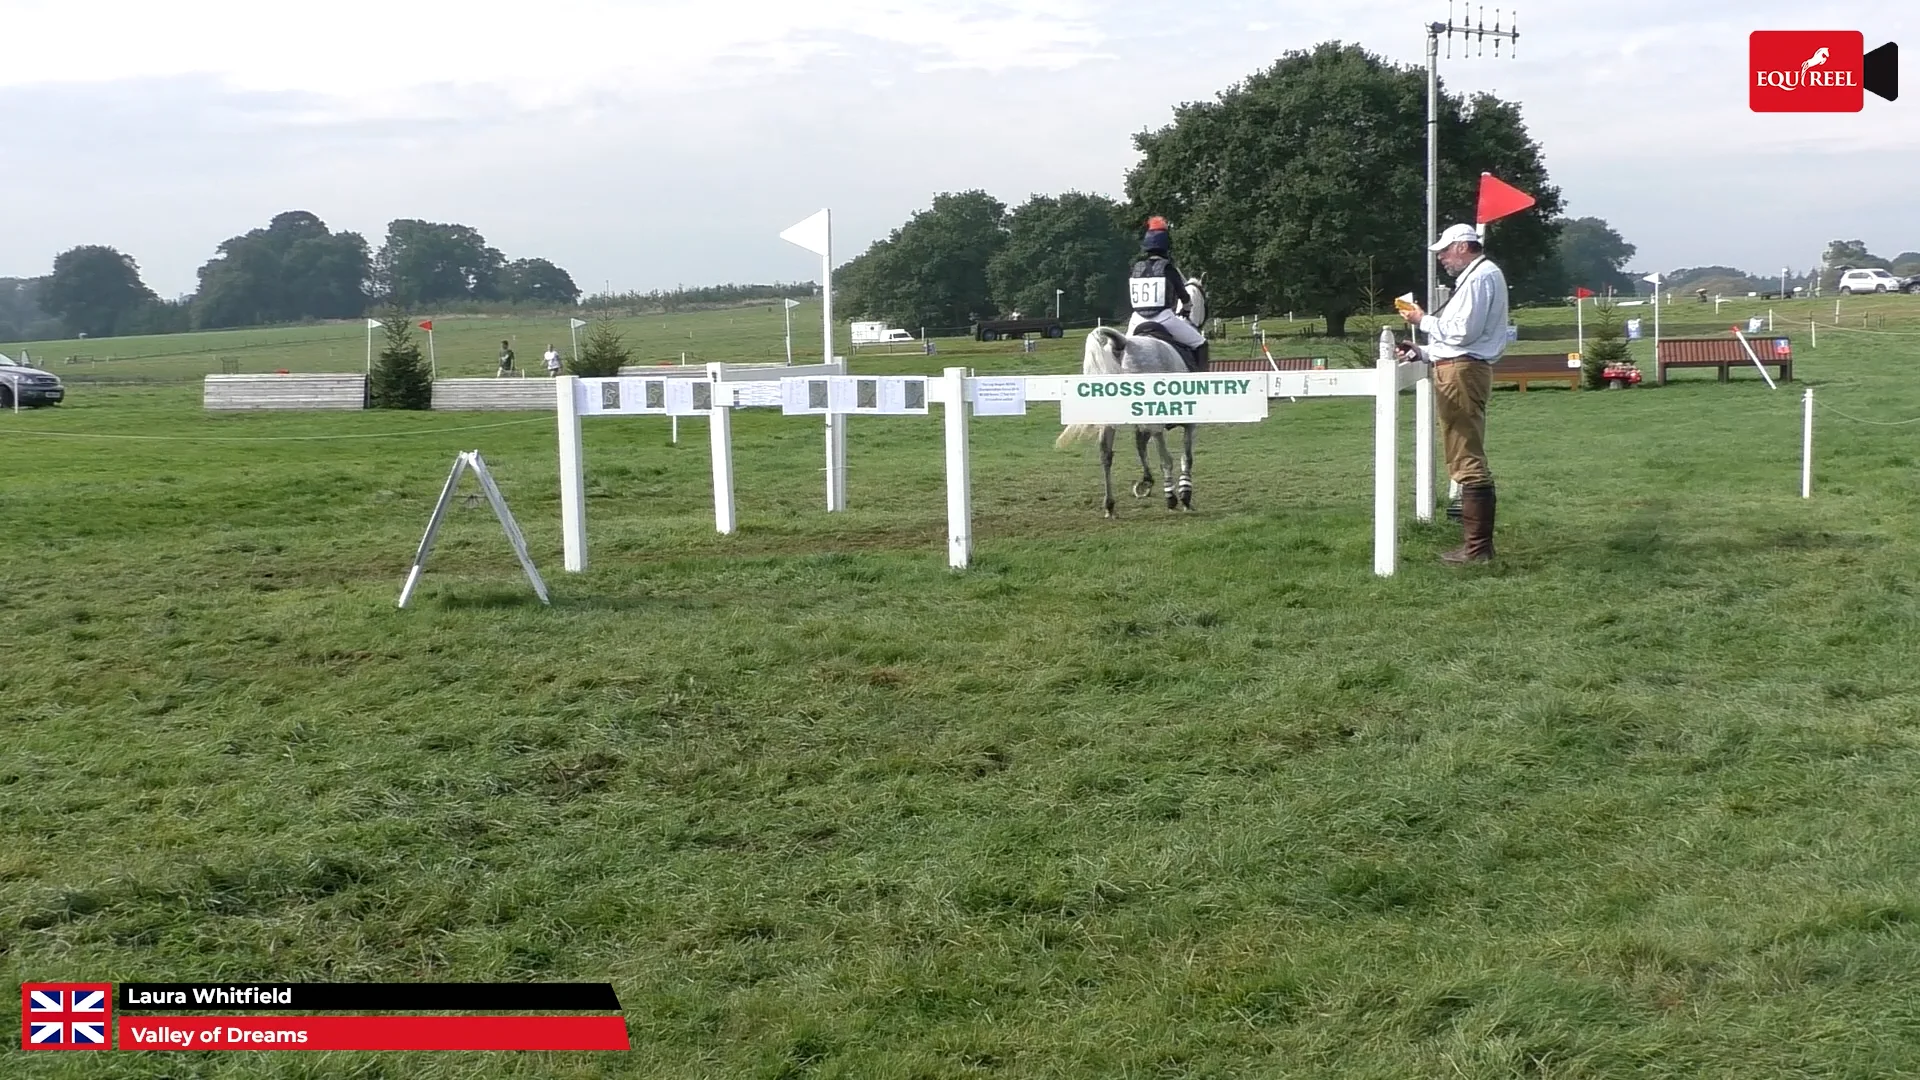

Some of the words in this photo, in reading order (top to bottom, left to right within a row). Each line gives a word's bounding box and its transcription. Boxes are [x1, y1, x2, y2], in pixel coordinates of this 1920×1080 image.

[1131, 281, 1159, 304] 561
[1077, 381, 1146, 398] CROSS
[1153, 379, 1251, 396] COUNTRY
[1131, 400, 1197, 417] START
